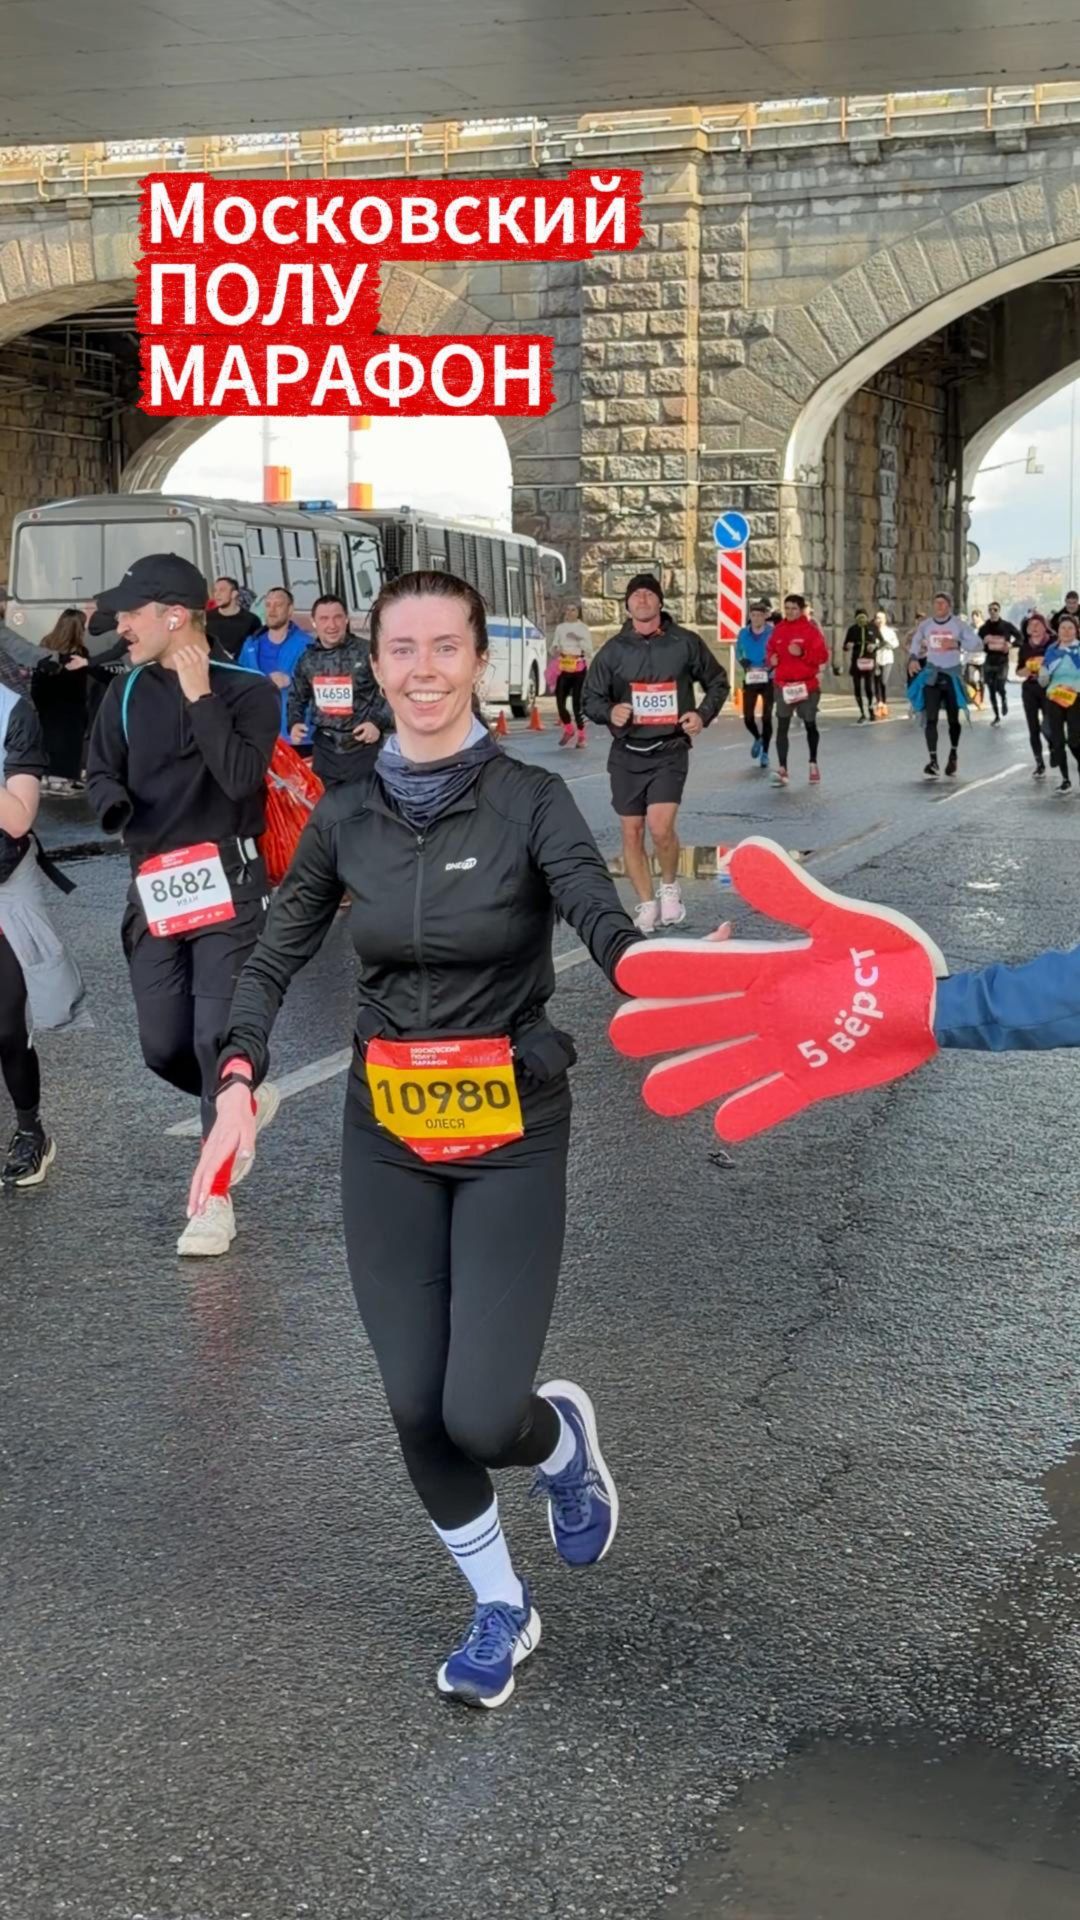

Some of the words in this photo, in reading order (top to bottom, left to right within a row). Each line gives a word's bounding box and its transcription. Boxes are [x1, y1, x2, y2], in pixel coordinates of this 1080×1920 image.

[316, 687, 351, 700] 14658
[635, 694, 674, 708] 16851
[151, 867, 216, 903] 8682
[797, 1039, 829, 1069] 5
[377, 1079, 511, 1116] 10980
[425, 1118, 466, 1129] ОЛЕСЯ
